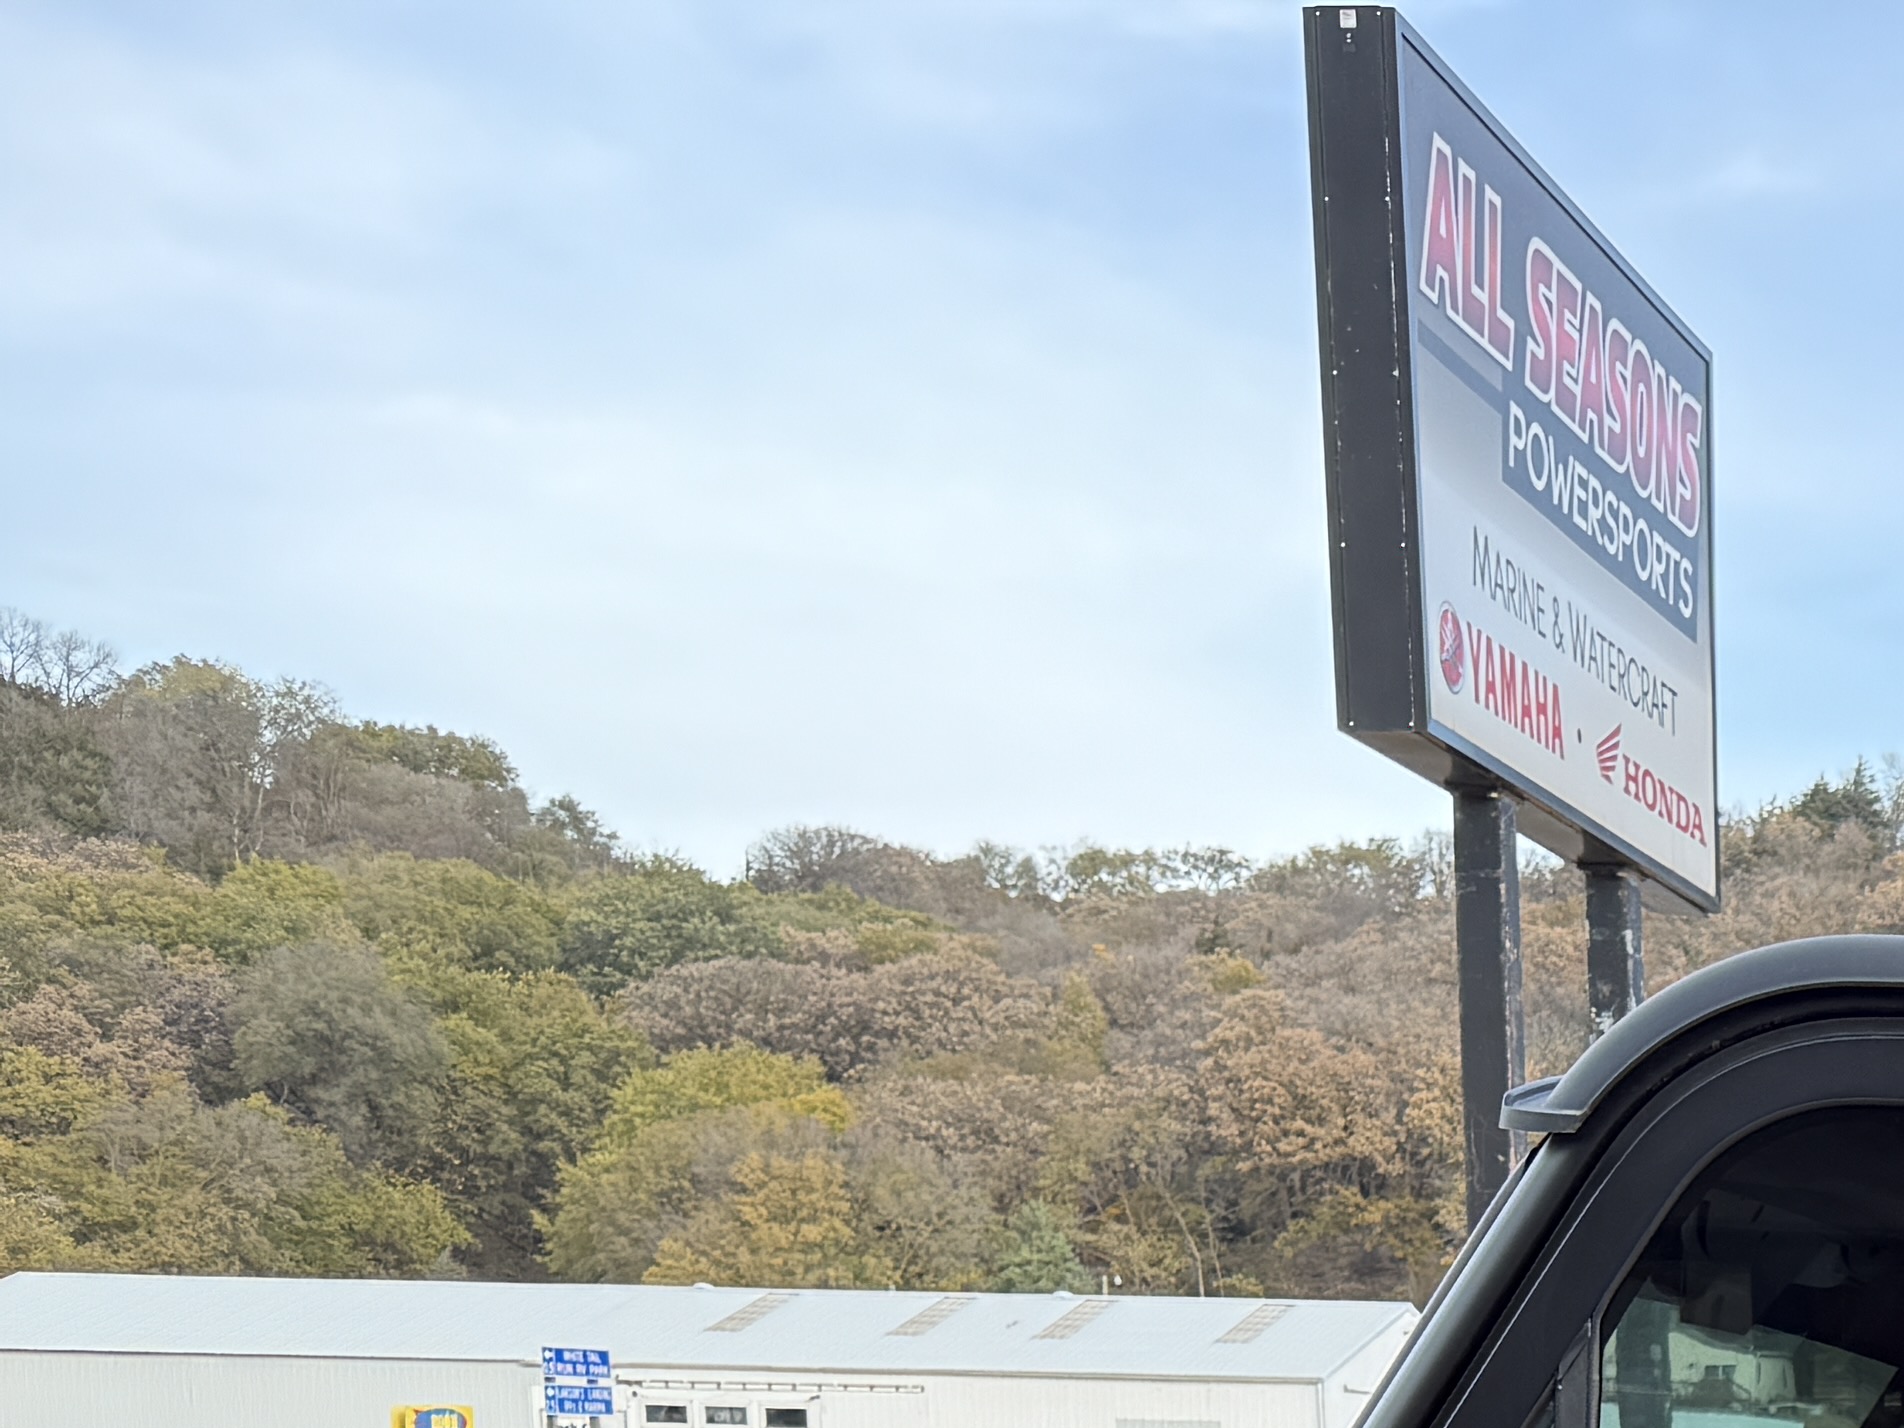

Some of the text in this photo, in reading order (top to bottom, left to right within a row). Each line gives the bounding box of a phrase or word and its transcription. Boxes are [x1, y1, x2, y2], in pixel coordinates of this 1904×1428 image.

[1419, 131, 1703, 538] ALL SEASONS
[1508, 400, 1694, 619] POWERSPORTS
[1466, 621, 1707, 848] YAMAHA HONDA
[1472, 525, 1678, 737] MARINE & WATERCRAFT
